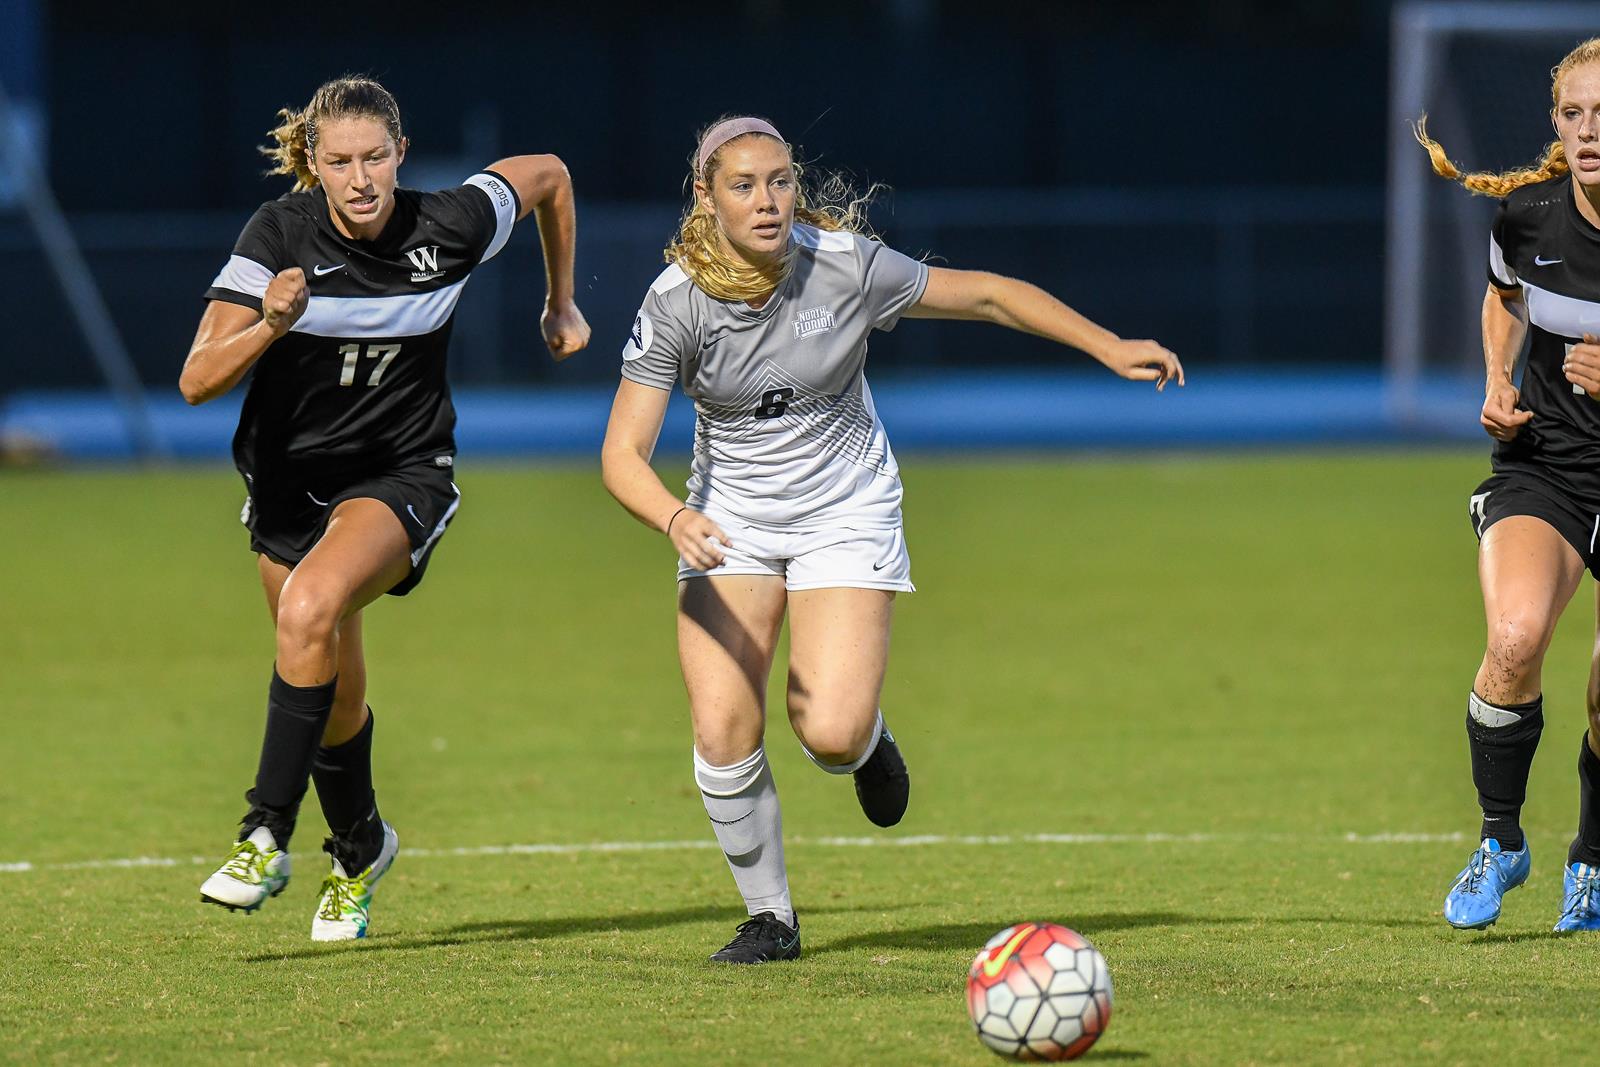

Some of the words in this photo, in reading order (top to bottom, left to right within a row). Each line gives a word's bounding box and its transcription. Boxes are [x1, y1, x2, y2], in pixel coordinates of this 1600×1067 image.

[404, 245, 440, 272] W
[794, 313, 835, 337] FLORIDA
[799, 307, 826, 322] NORTH
[338, 343, 402, 387] 17
[754, 387, 794, 420] 6
